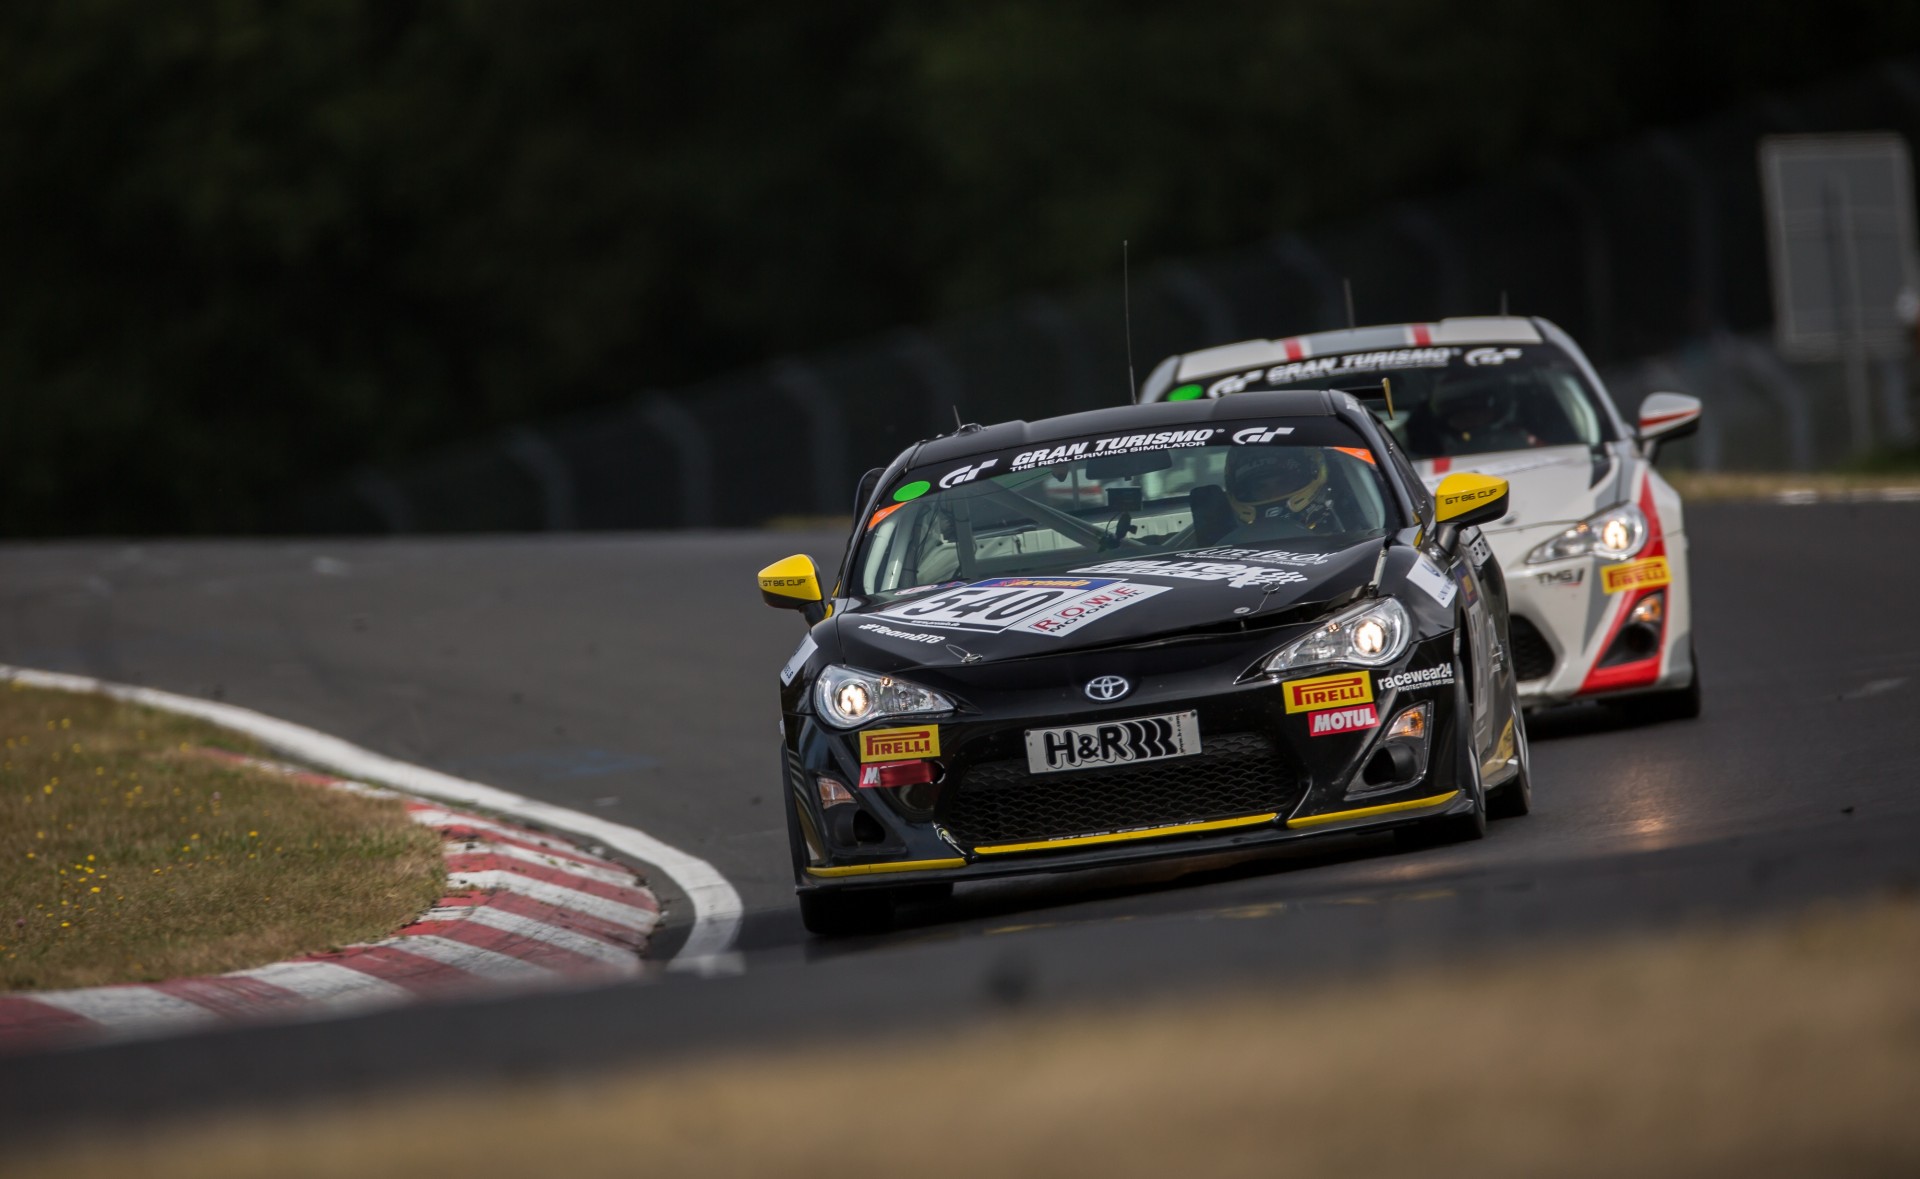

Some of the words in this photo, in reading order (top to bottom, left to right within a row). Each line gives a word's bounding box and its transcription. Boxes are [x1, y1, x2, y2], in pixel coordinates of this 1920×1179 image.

[1267, 356, 1338, 379] GRAN
[1009, 464, 1036, 473] THE
[1038, 456, 1073, 468] REAL
[1074, 447, 1132, 461] DRIVING
[1133, 440, 1206, 453] SIMULATOR
[1012, 441, 1090, 467] GRAN
[1477, 488, 1498, 499] CUP
[786, 578, 806, 587] CUP
[1607, 562, 1666, 589] PIRELLI
[903, 589, 1065, 621] 540
[1031, 585, 1139, 631] ROWE
[1047, 602, 1112, 633] MOTOR
[1114, 591, 1144, 602] OIL
[858, 623, 946, 644] #TeamBTG
[1377, 662, 1453, 691] racewear24
[1398, 682, 1432, 692] PROTECTION
[1292, 677, 1365, 707] PIRELLI
[1313, 707, 1376, 733] MOTUL
[866, 730, 931, 756] PIRELLI
[1044, 720, 1160, 769] H&R
